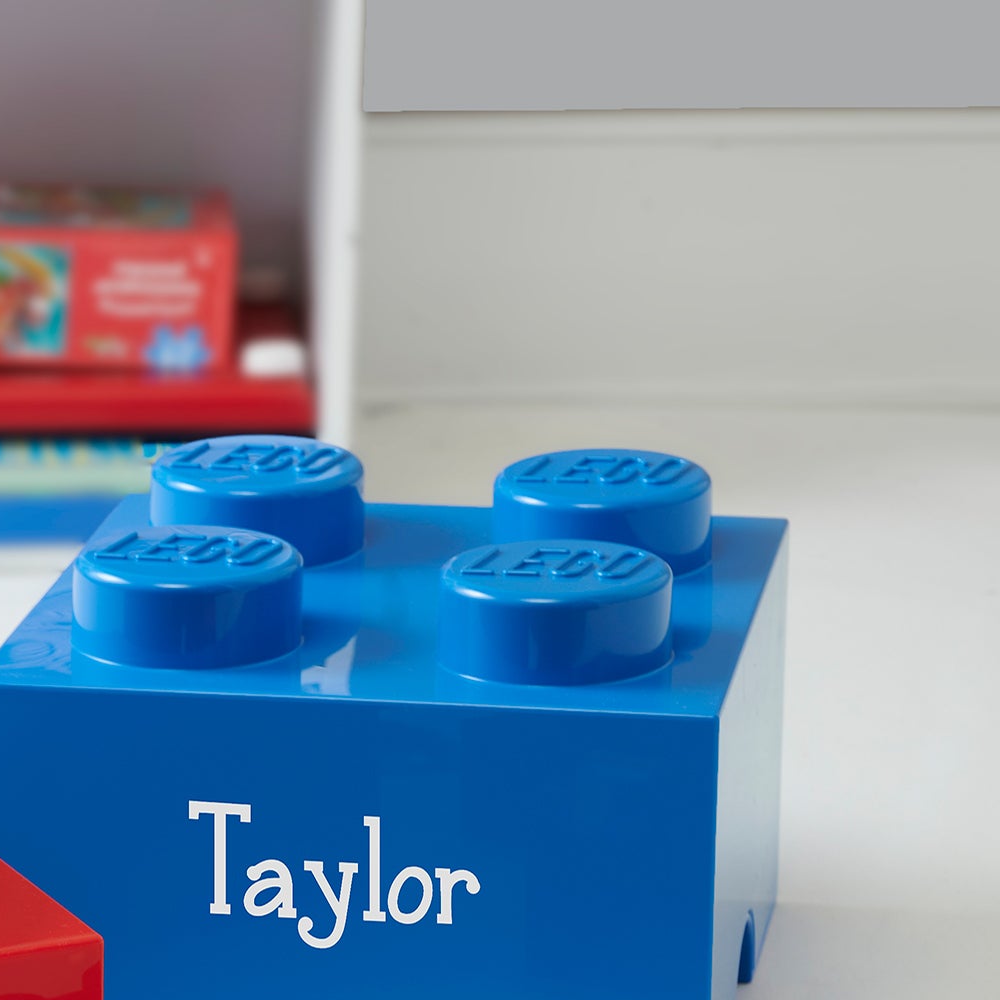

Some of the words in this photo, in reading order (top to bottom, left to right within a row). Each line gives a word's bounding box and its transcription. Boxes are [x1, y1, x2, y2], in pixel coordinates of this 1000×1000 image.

[170, 442, 344, 474] LEGO
[513, 455, 692, 485] LEGO
[93, 531, 284, 567] LEGO
[460, 548, 646, 580] LEGO
[188, 800, 481, 949] Taylor
